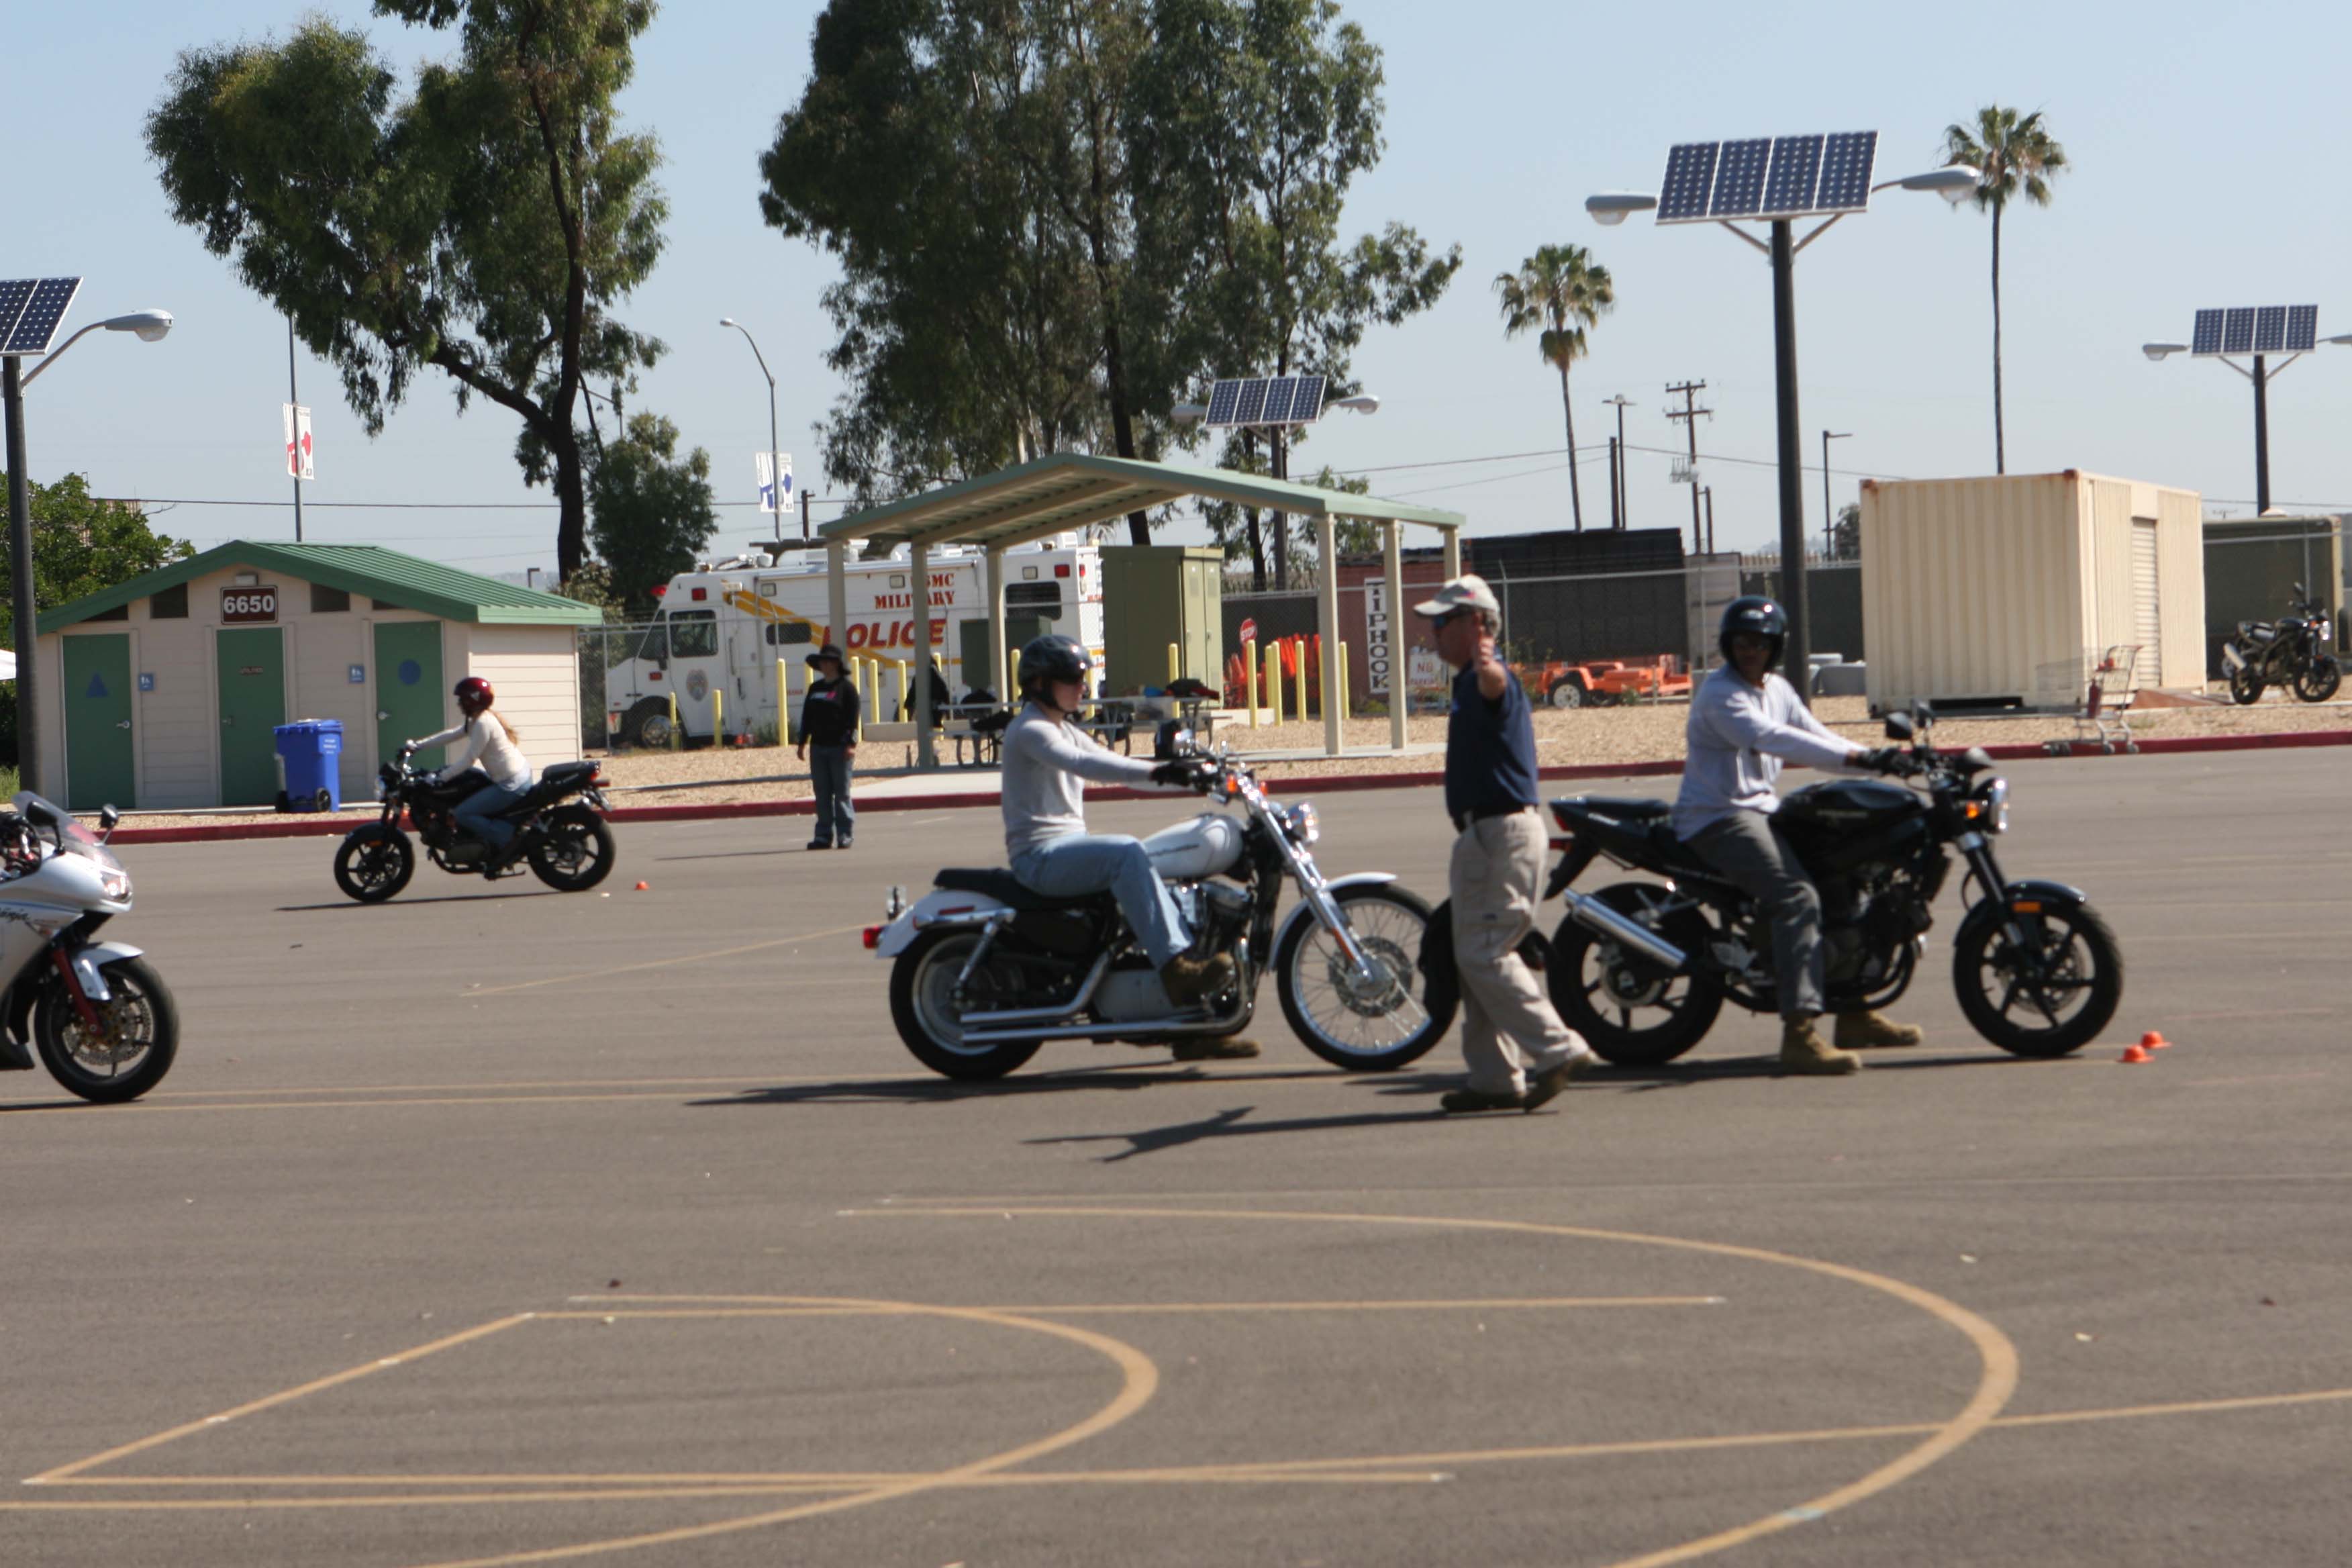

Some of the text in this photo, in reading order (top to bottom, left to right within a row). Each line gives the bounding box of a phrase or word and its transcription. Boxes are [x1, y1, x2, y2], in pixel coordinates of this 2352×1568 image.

[224, 595, 275, 614] 6650
[874, 591, 954, 609] MILIARY
[1240, 626, 1256, 641] STOP
[1365, 581, 1388, 688] TIPHOOK
